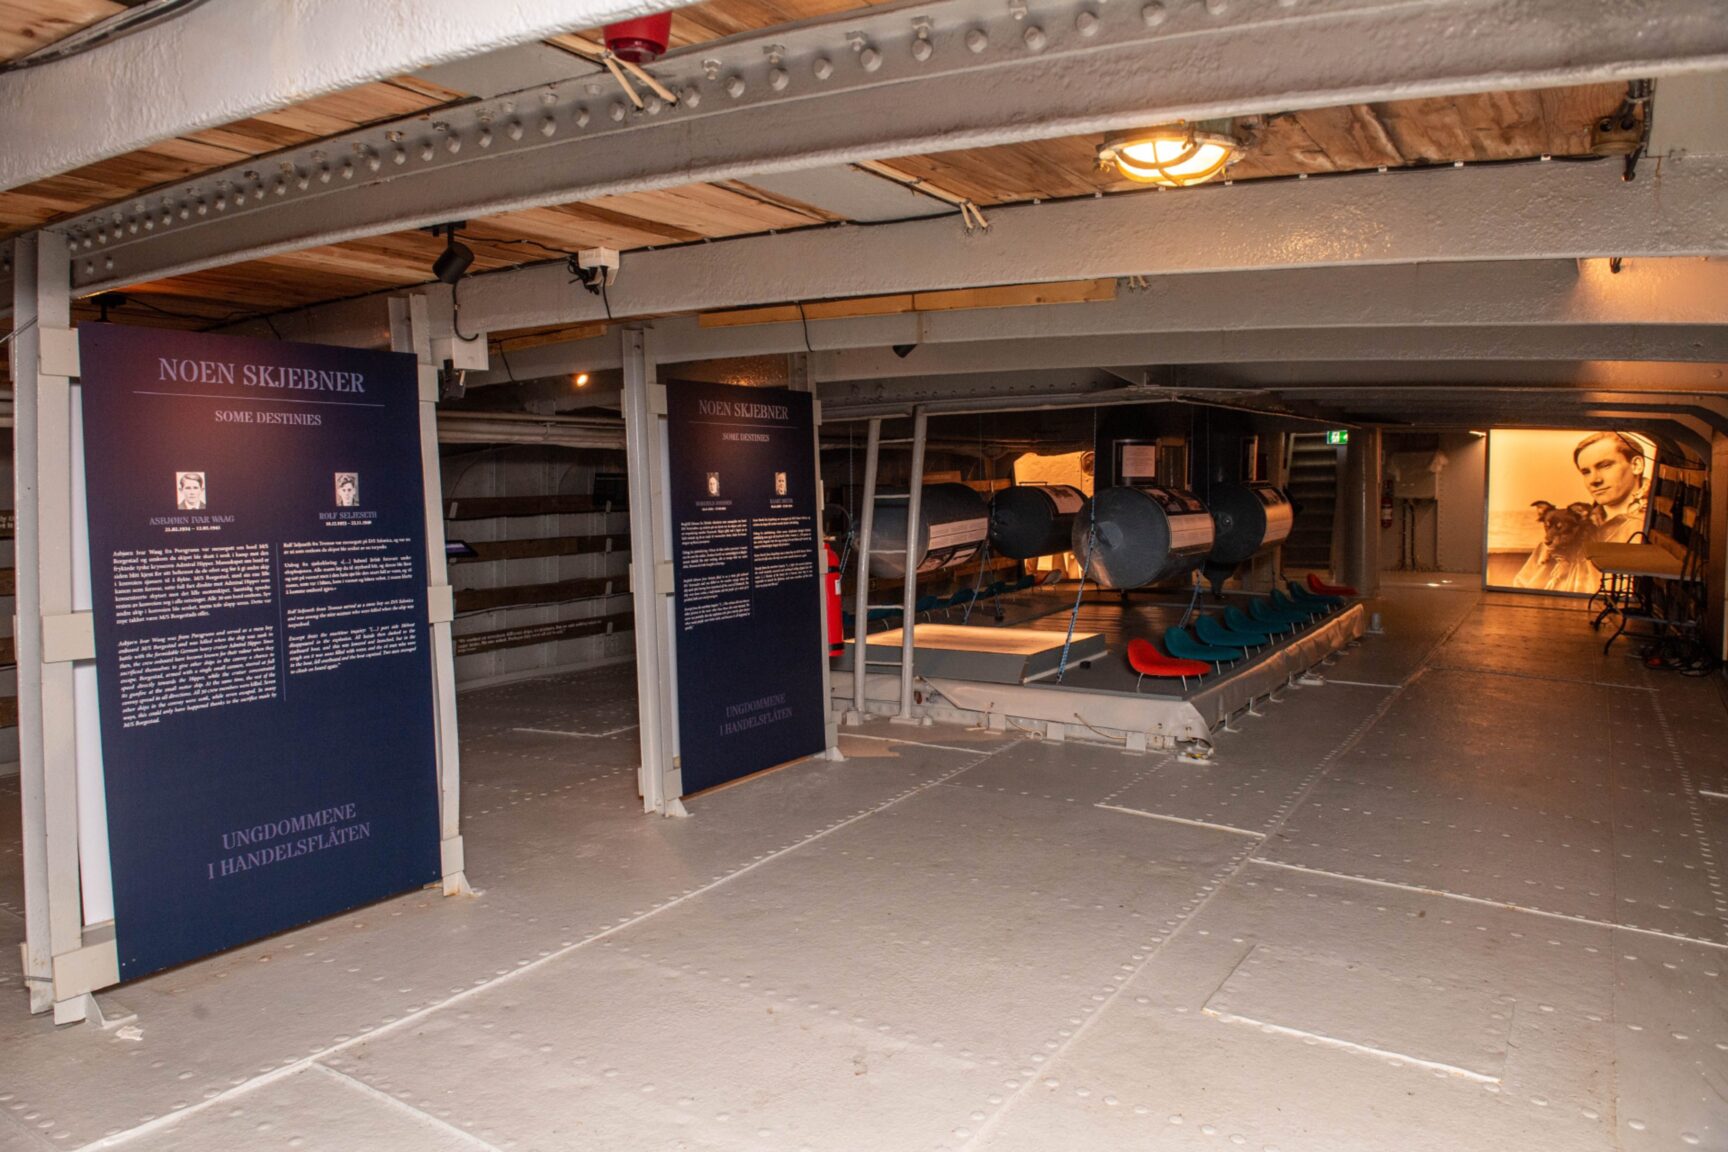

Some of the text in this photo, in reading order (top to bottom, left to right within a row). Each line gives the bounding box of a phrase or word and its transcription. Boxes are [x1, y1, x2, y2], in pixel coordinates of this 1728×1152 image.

[158, 357, 366, 393] NOEN SKJEBNER
[215, 409, 322, 426] SOME DESTINIES
[698, 399, 788, 420] NOEN SKJEBNER
[722, 432, 770, 442] SOME DESTINIES
[149, 514, 236, 526] ASBJØRN IVAR WAAG
[319, 512, 338, 520] ROLF
[722, 693, 786, 718] UNGDOMMENE
[720, 725, 724, 736] I
[222, 803, 357, 850] UNGDOMMENE
[208, 822, 372, 880] I HANDELSFLÅTEN
